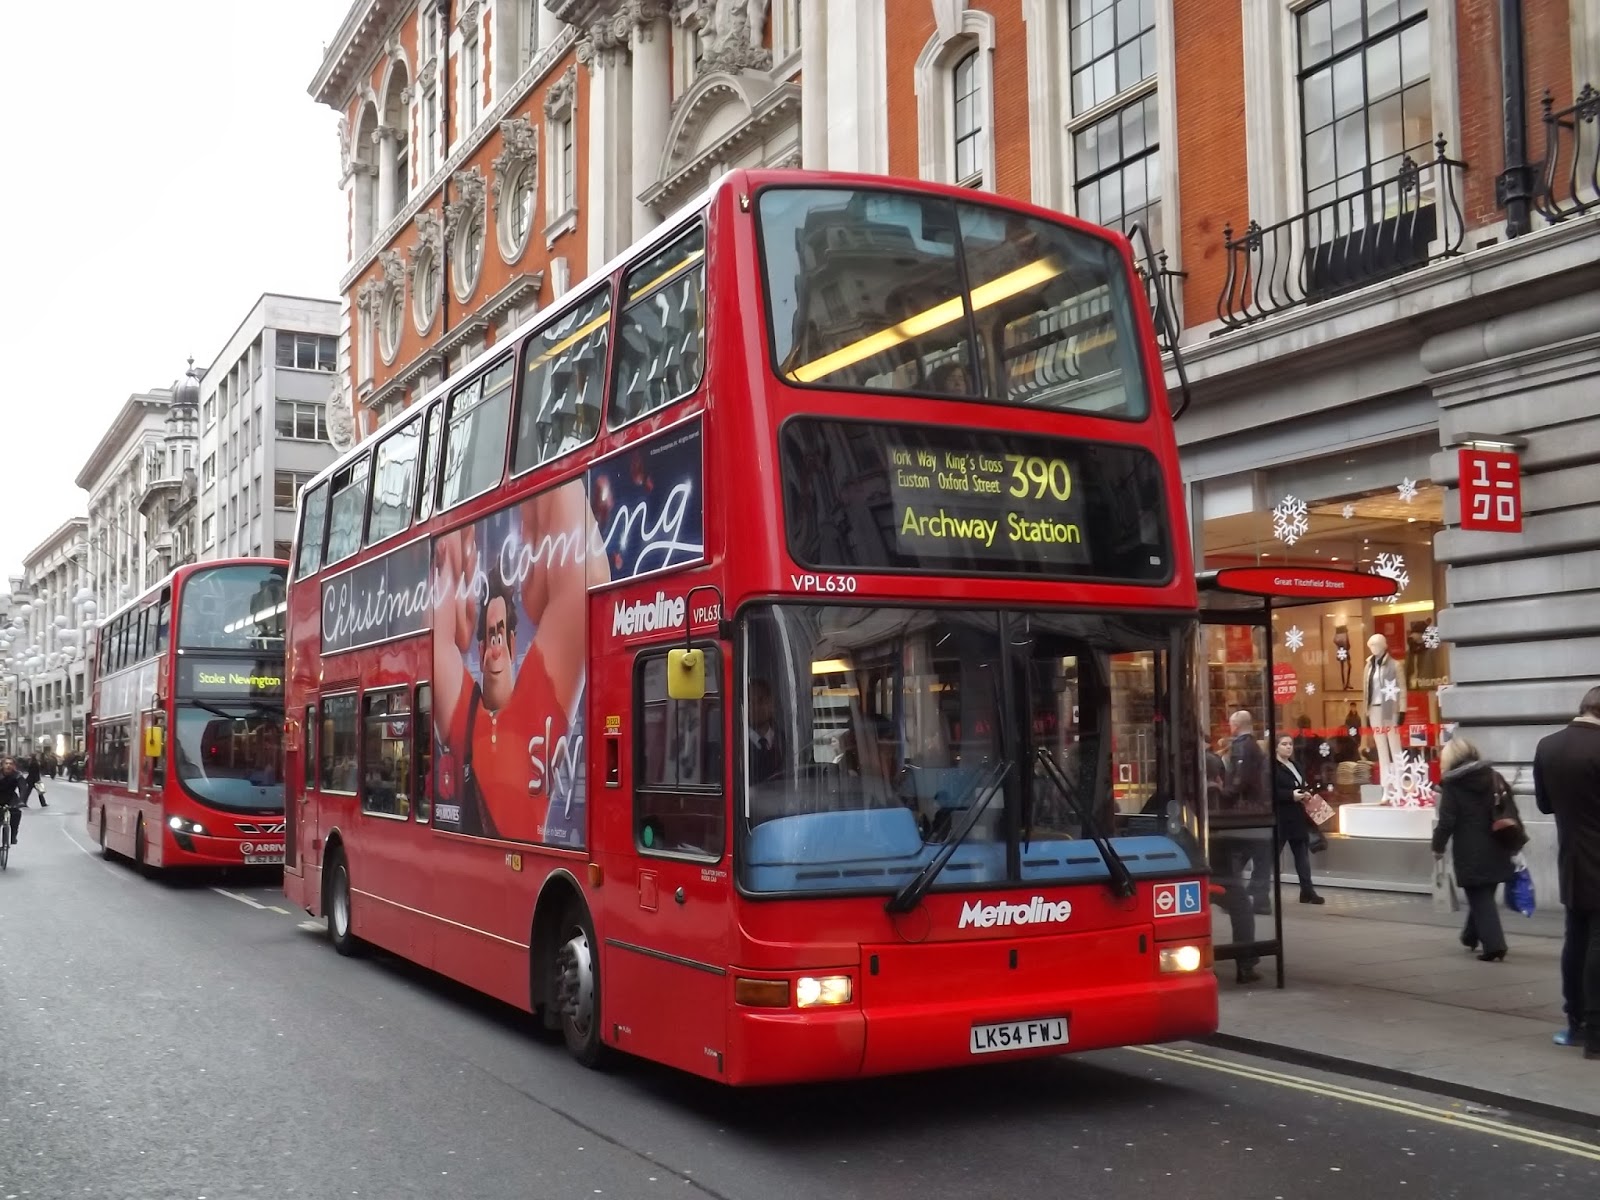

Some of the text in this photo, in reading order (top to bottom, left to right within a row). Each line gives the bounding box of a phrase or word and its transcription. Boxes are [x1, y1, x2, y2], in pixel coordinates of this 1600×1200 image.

[917, 450, 937, 472] Way
[945, 451, 976, 474] King's
[979, 454, 1004, 473] Cross
[897, 470, 1001, 493] Euston Oxford Street
[1005, 454, 1072, 501] 390
[901, 507, 1081, 547] Archway Station
[790, 574, 857, 593] VPL630
[1274, 577, 1345, 588] Great Titchfield Street
[612, 591, 685, 637] Metroline
[199, 672, 281, 689] Stoke Newington
[528, 715, 584, 820] sky
[255, 843, 286, 852] ARRIV
[957, 896, 1072, 929] Metroline
[973, 1020, 1063, 1050] LK54 FWJ
